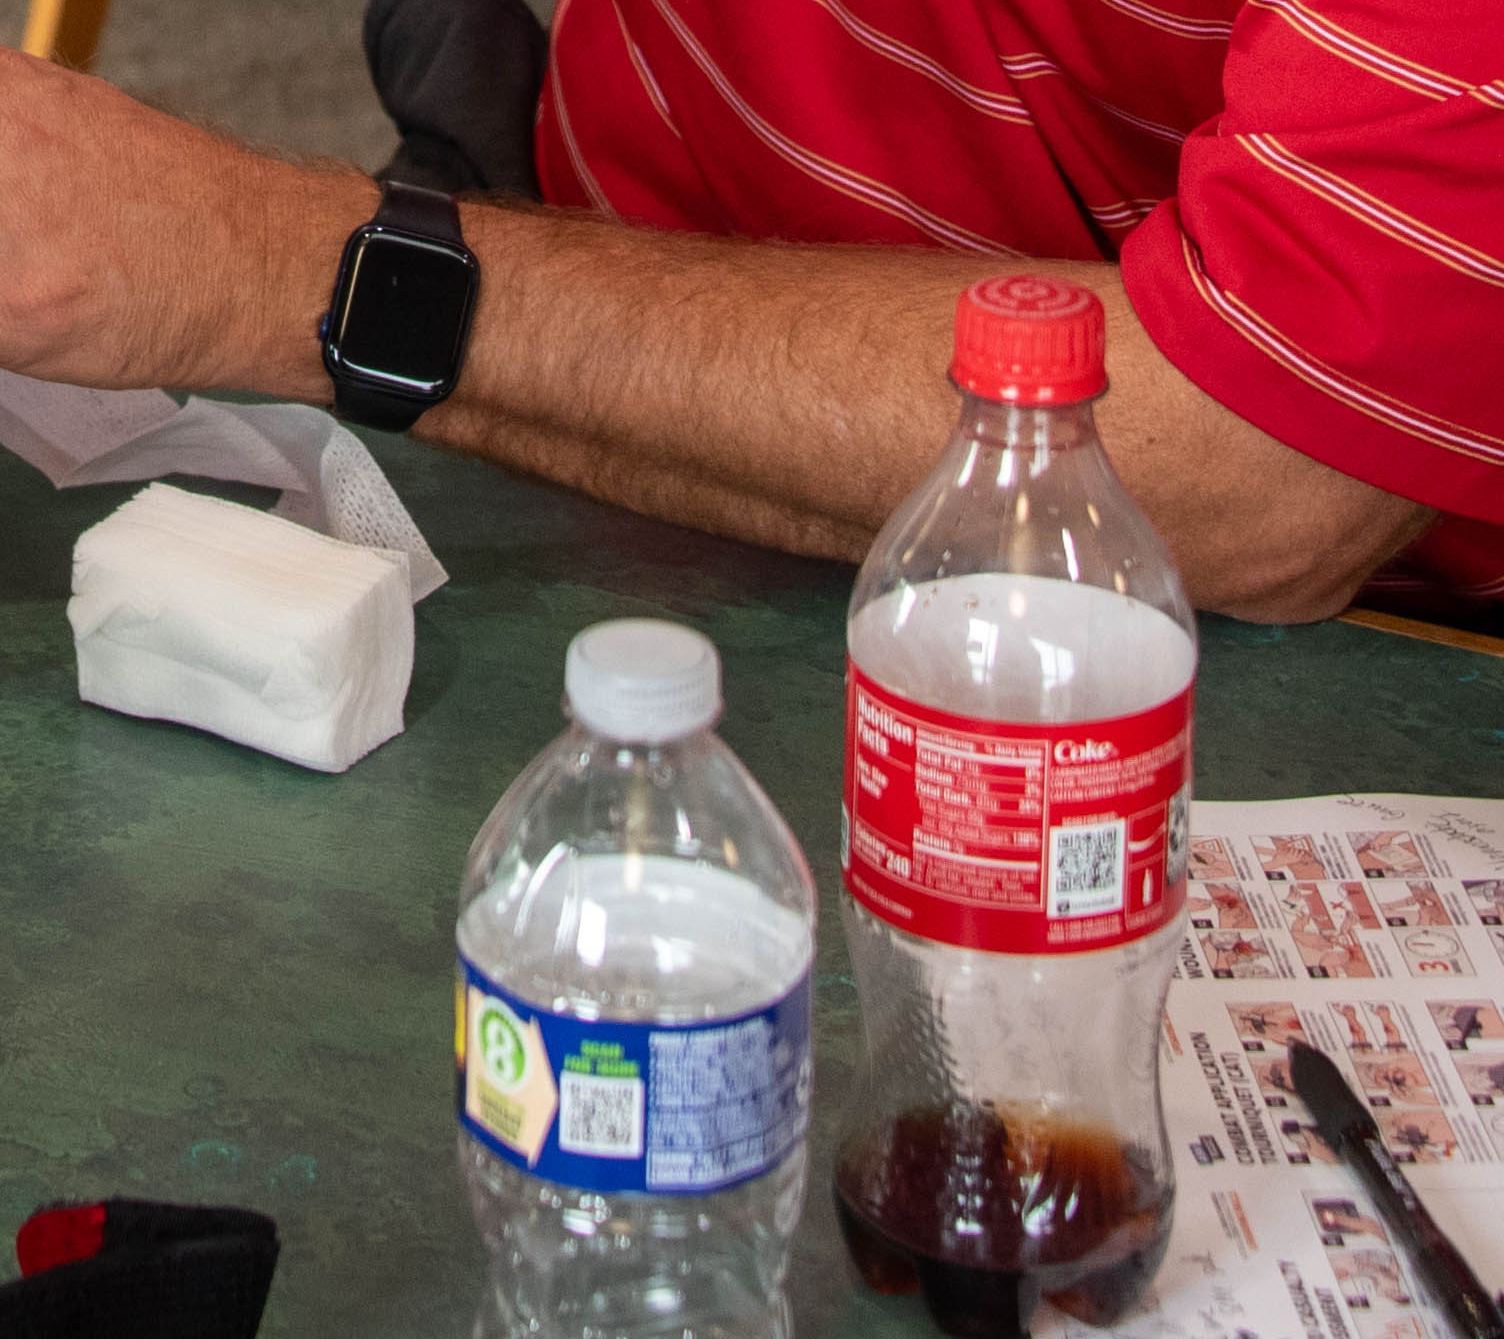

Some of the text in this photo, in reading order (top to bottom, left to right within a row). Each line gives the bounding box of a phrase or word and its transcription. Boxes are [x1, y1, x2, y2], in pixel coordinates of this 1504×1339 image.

[858, 693, 915, 747] Nutrition
[858, 716, 890, 757] Facts
[1054, 739, 1114, 764] Coke
[1189, 1031, 1235, 1110] APPLICATION
[1221, 1111, 1255, 1166] COMBAT
[1232, 1086, 1278, 1166] TOURNIQUET
